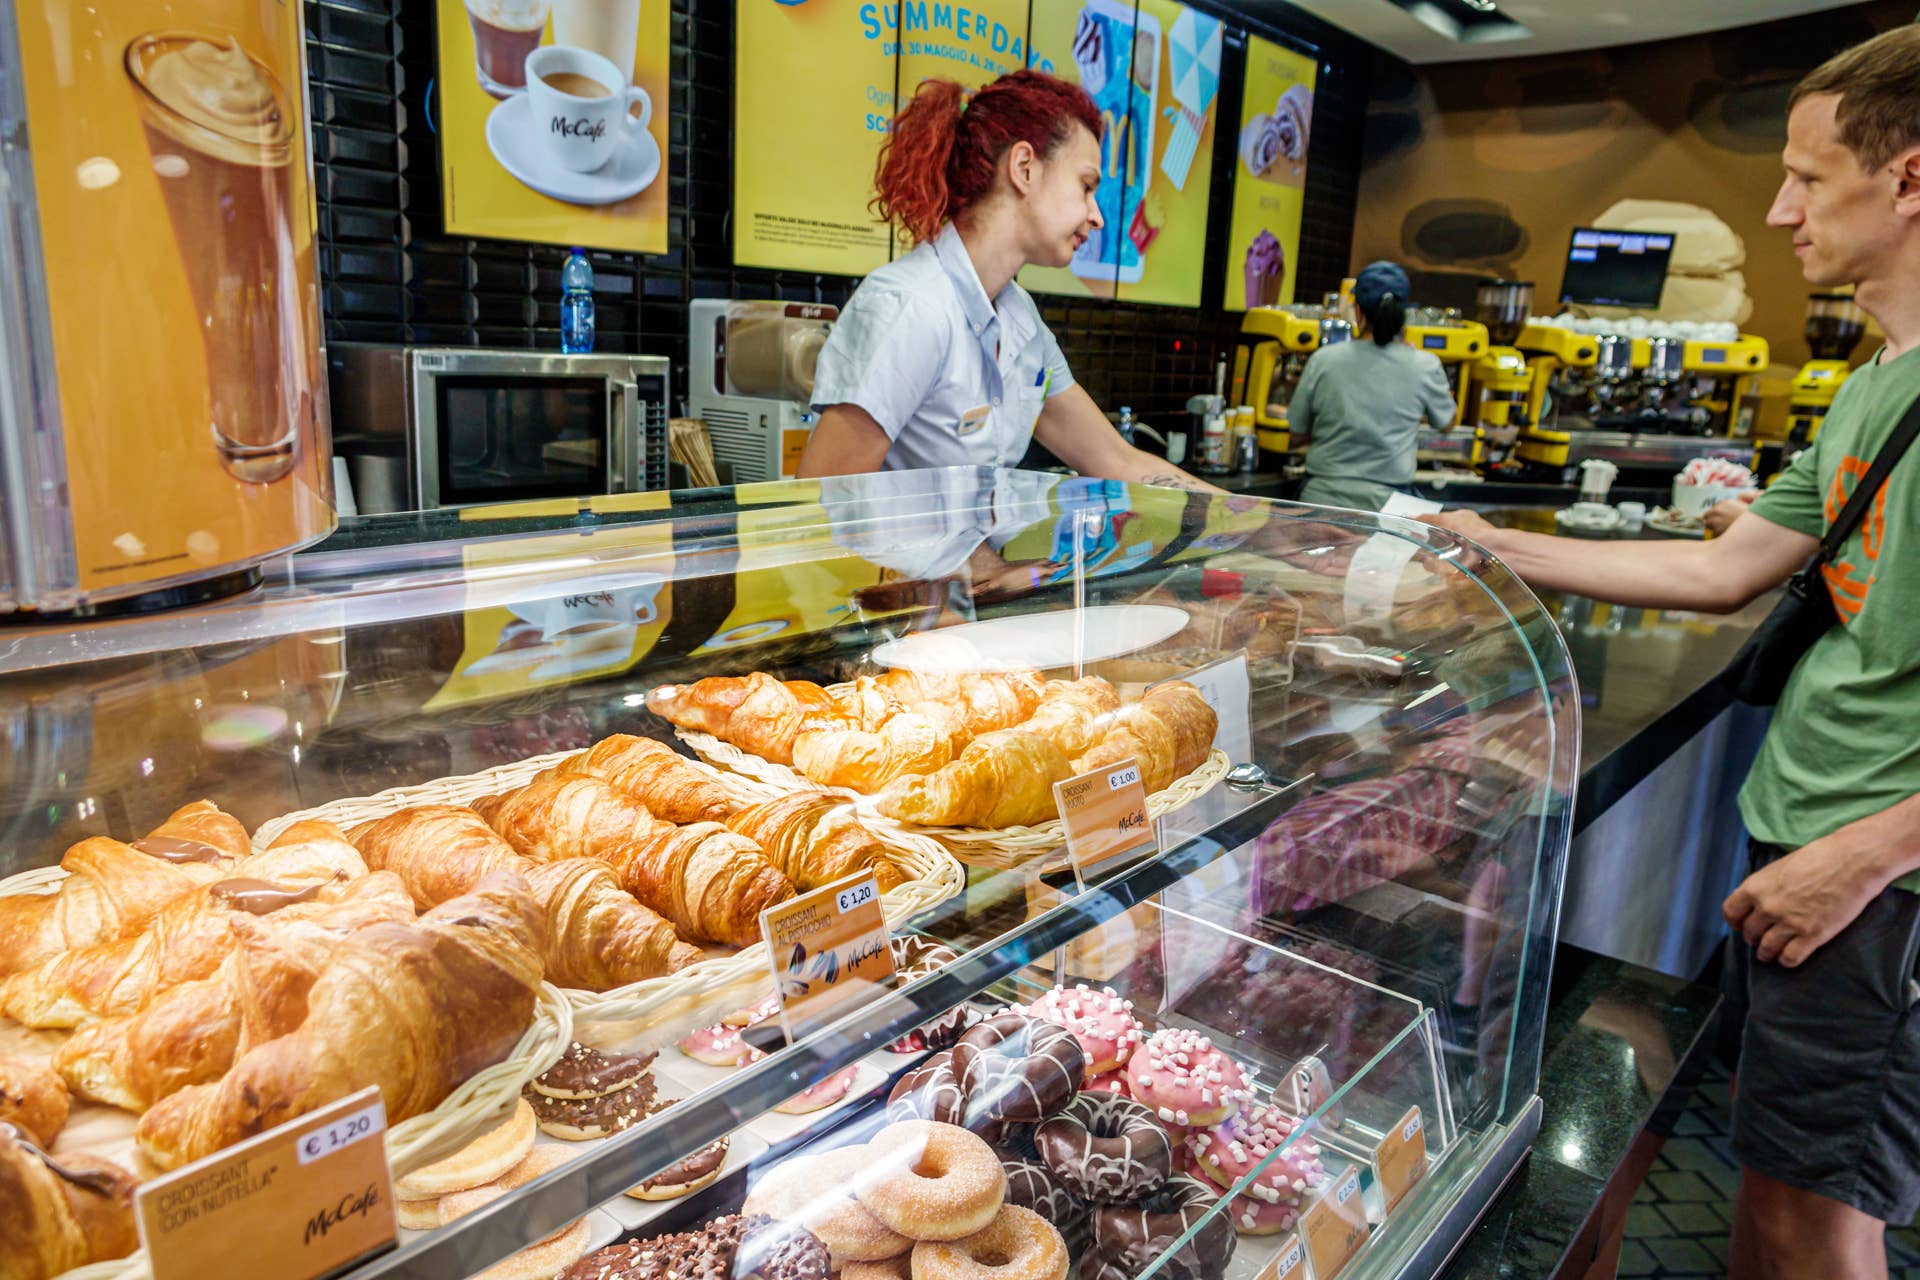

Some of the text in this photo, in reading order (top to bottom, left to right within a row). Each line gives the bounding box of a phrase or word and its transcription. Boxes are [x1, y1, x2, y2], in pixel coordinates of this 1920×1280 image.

[909, 42, 921, 55] 30
[923, 43, 968, 62] MAGGIO
[969, 53, 981, 67] AL
[1063, 780, 1093, 798] CROISSANT
[840, 886, 871, 909] € 1,20
[775, 905, 817, 933] CROISSANT
[304, 1115, 370, 1156] € 1,20
[158, 1159, 249, 1215] CROISSANT
[161, 1208, 198, 1234] CON
